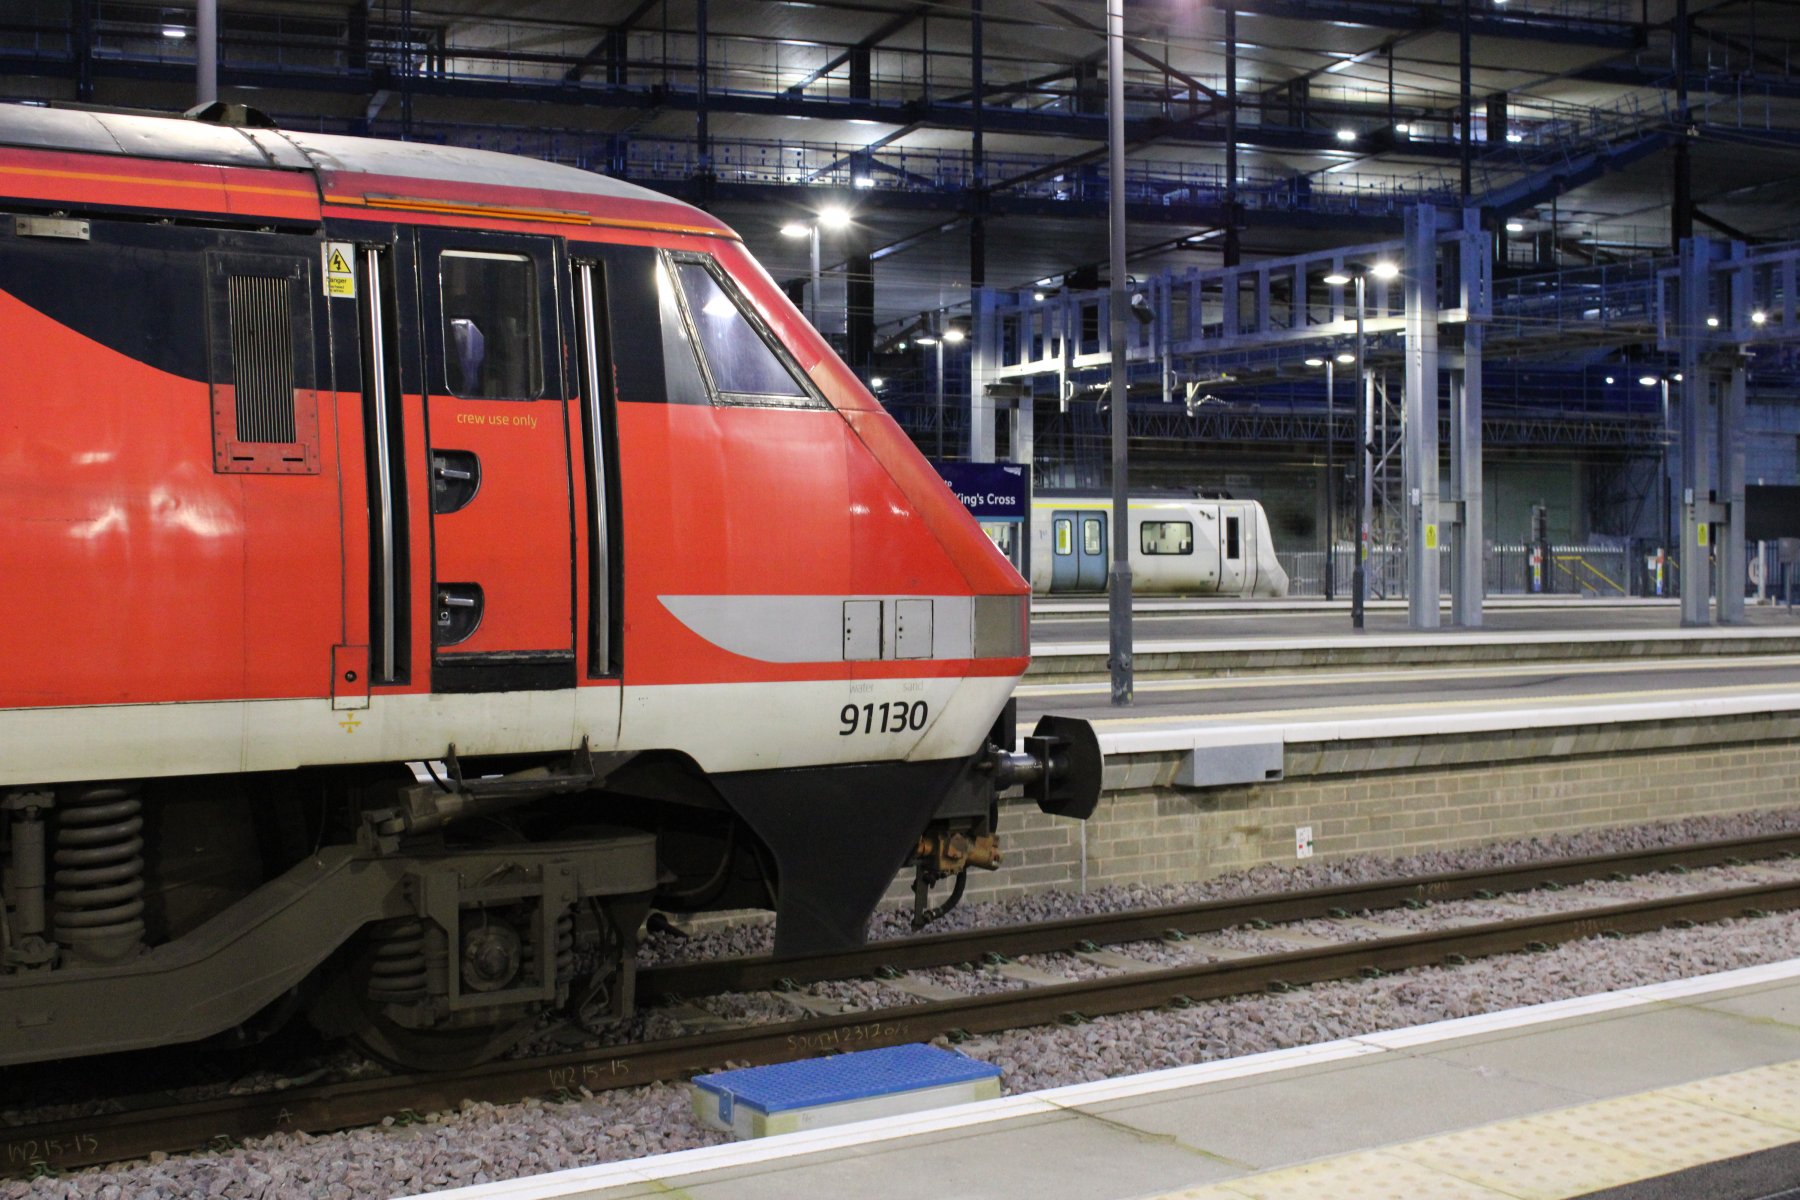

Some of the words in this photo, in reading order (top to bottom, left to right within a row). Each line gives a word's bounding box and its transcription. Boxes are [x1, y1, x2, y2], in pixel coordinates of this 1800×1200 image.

[456, 413, 485, 424] crew
[488, 414, 510, 425] use
[512, 414, 538, 429] only
[987, 493, 1016, 505] Cross
[850, 683, 874, 694] water
[902, 680, 924, 692] sand
[839, 700, 929, 736] 91130
